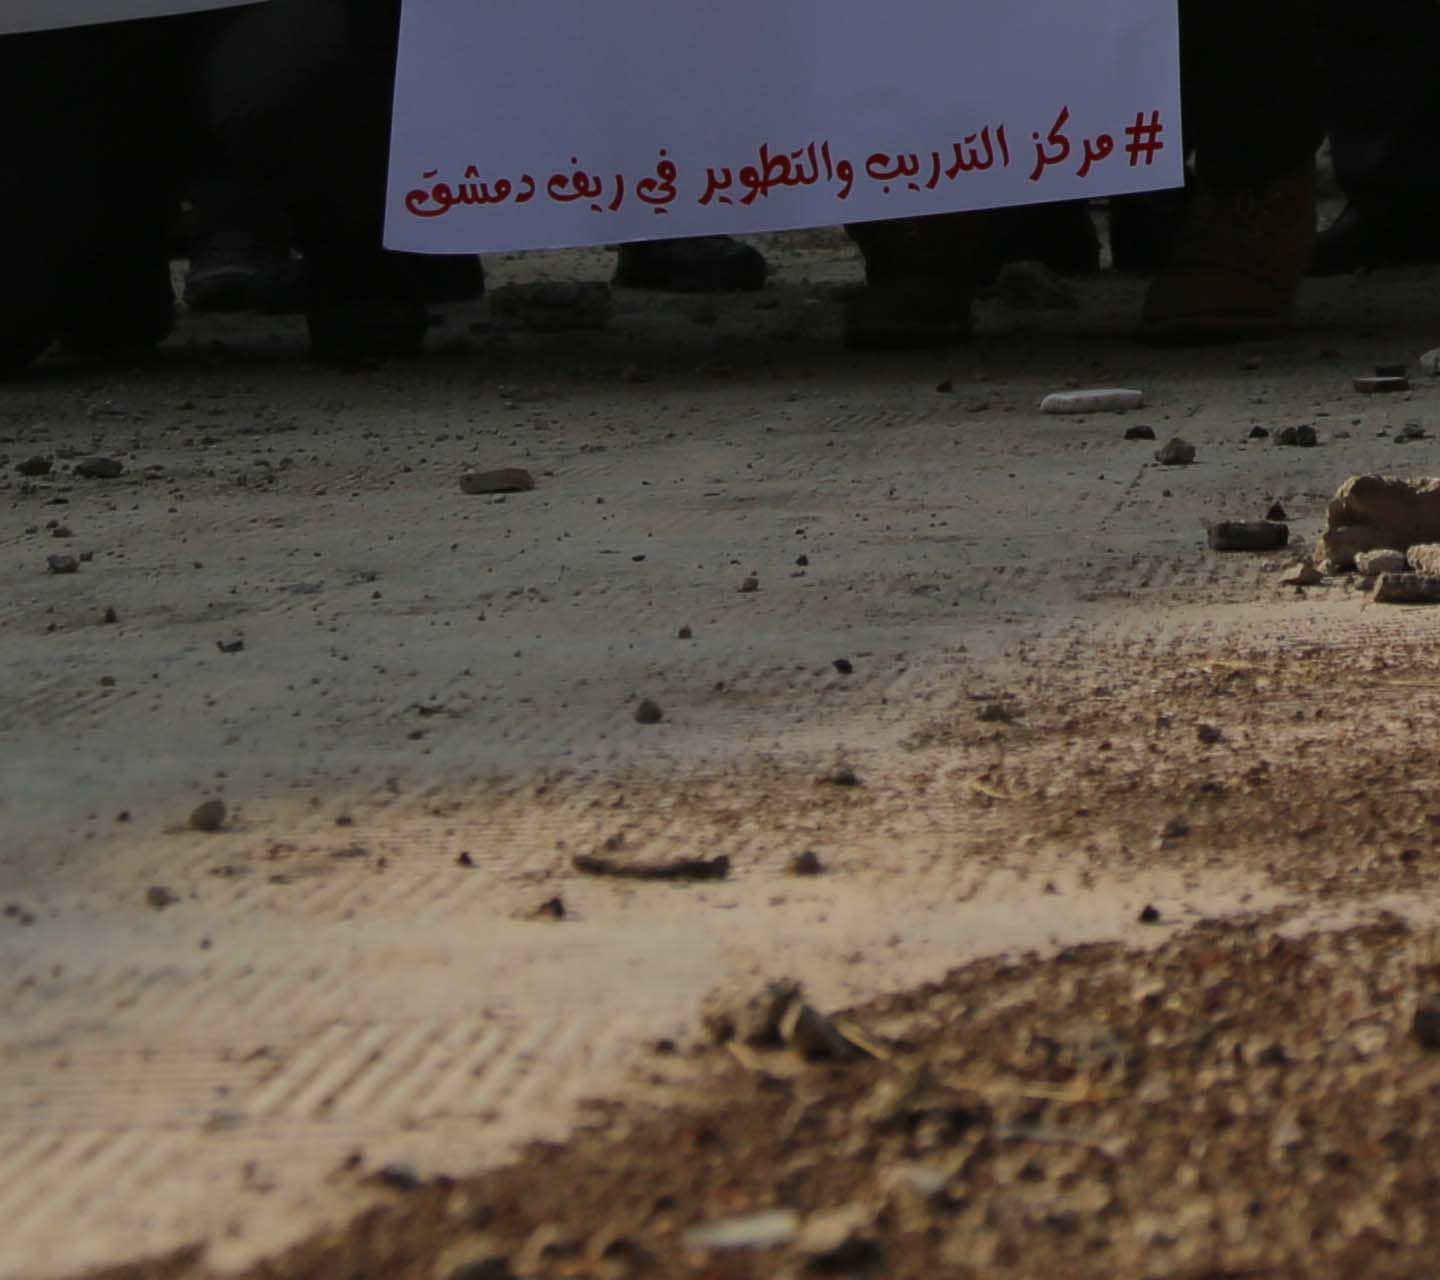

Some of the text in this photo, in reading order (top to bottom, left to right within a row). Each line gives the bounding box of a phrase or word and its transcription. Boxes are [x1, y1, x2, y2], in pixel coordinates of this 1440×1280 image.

[404, 165, 536, 218] دمشق
[547, 156, 624, 214] ريف
[636, 149, 677, 215] في
[698, 139, 855, 205] والتطوير
[866, 124, 1010, 193] التدريب
